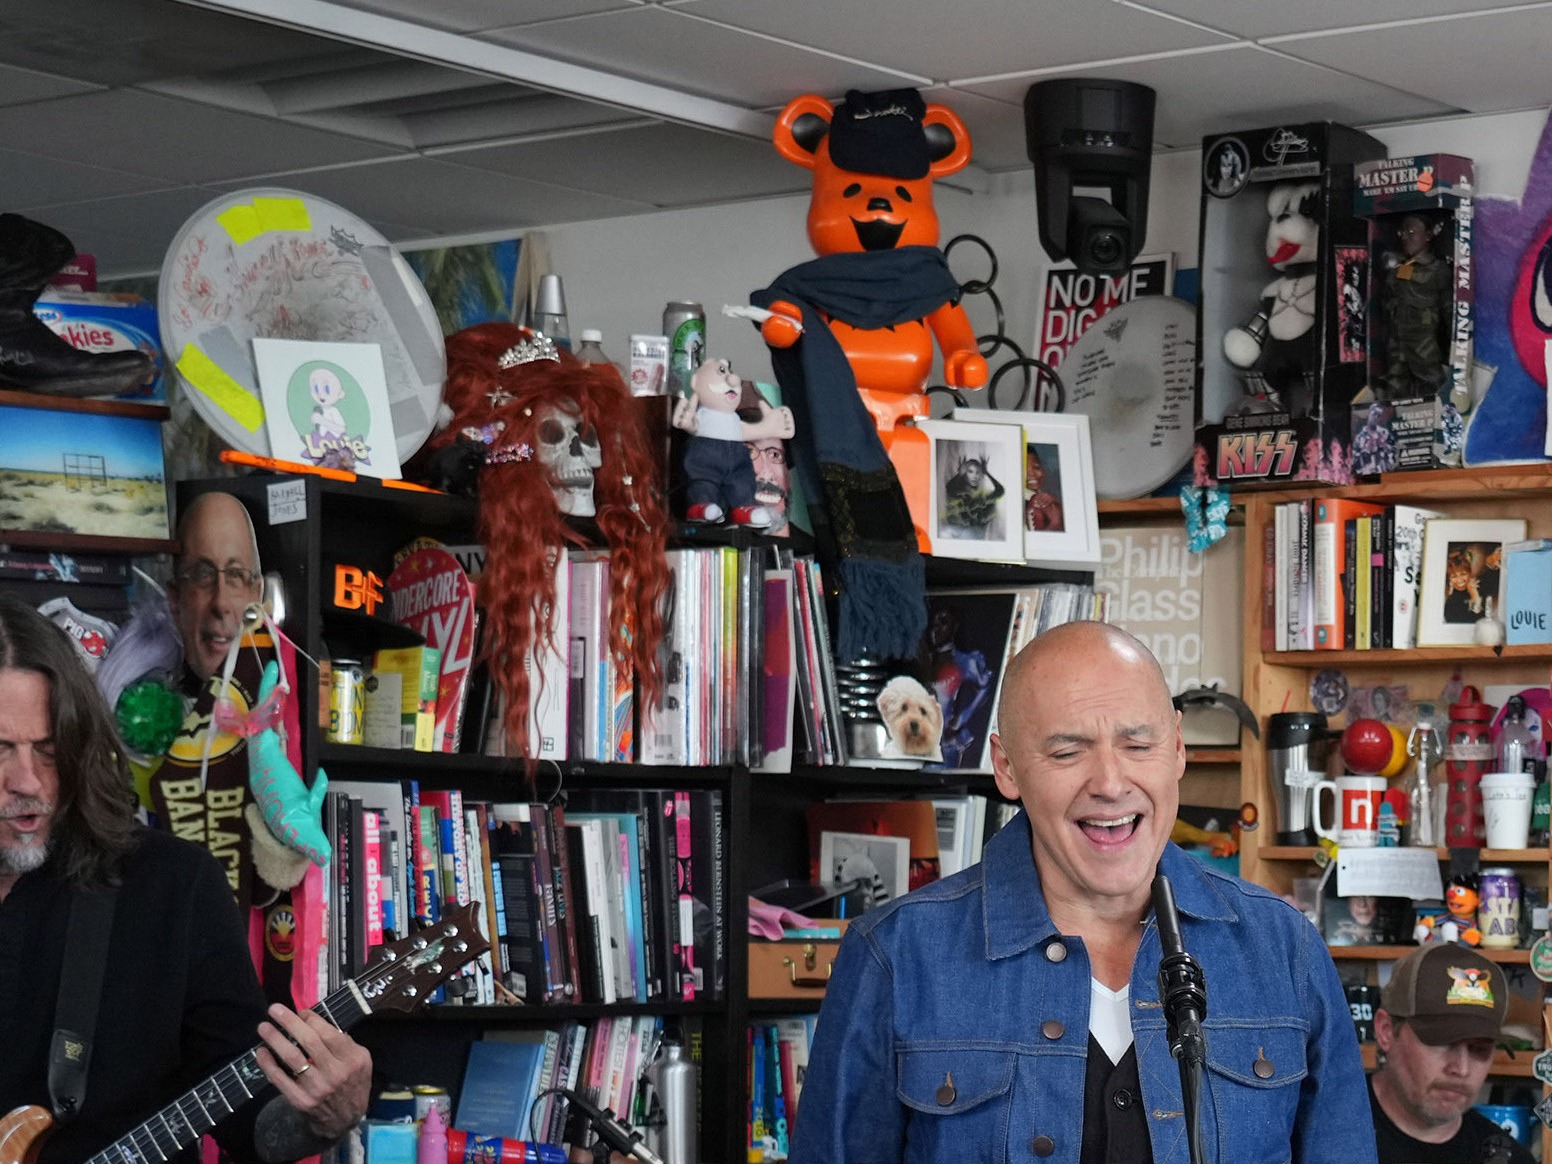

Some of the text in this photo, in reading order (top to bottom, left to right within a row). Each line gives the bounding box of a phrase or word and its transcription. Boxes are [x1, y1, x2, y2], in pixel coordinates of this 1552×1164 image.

[1359, 167, 1417, 189] MASTER
[1457, 196, 1473, 289] MASTER
[1050, 269, 1150, 308] NO ME
[1217, 430, 1298, 479] KISS
[1100, 534, 1203, 588] Philip
[1510, 611, 1548, 631] LOUIE
[714, 811, 722, 860] LEONARD
[364, 812, 383, 933] all about
[714, 861, 723, 916] BERNSTEIN
[715, 930, 723, 960] WORK
